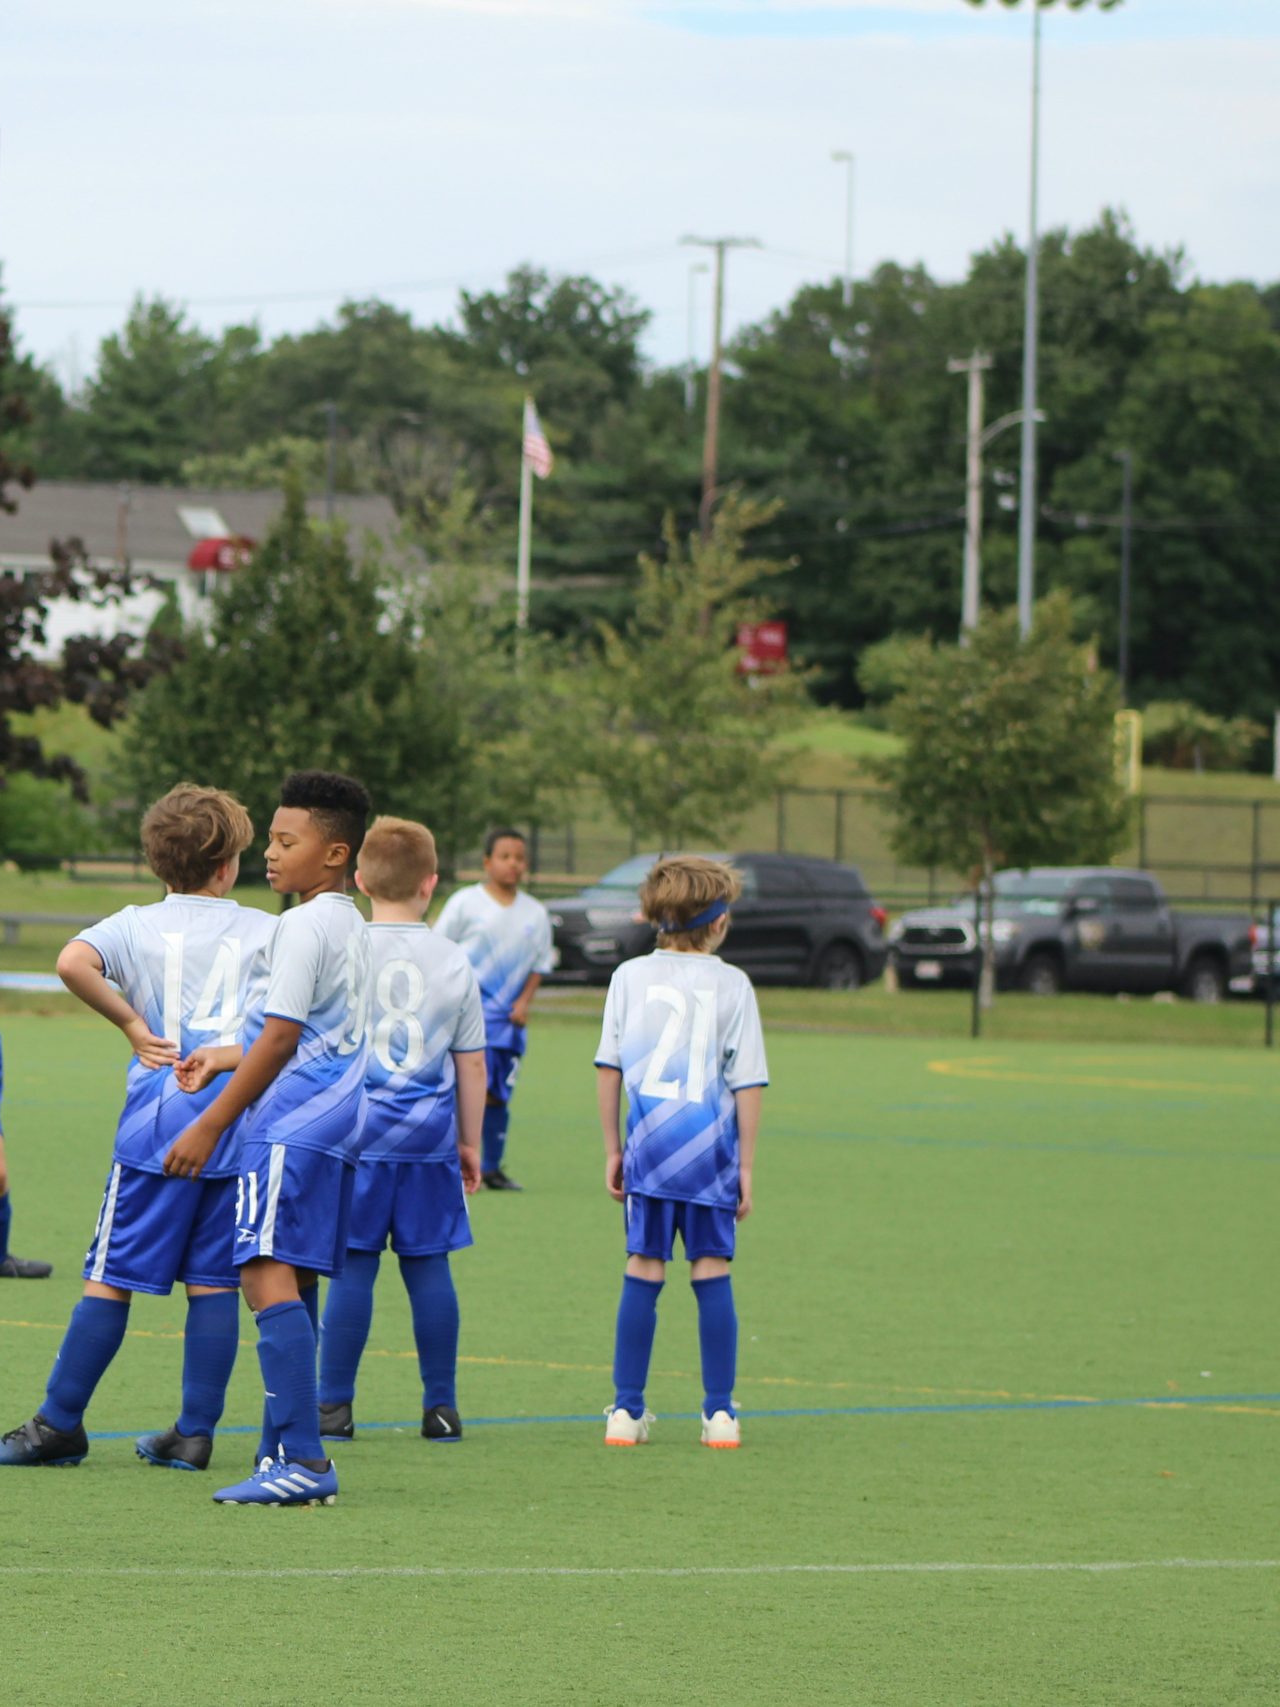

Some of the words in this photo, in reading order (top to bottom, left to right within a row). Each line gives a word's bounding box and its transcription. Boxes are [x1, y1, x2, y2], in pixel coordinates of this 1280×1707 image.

[160, 932, 243, 1051] 14
[374, 960, 424, 1074] 8
[638, 984, 714, 1103] 21
